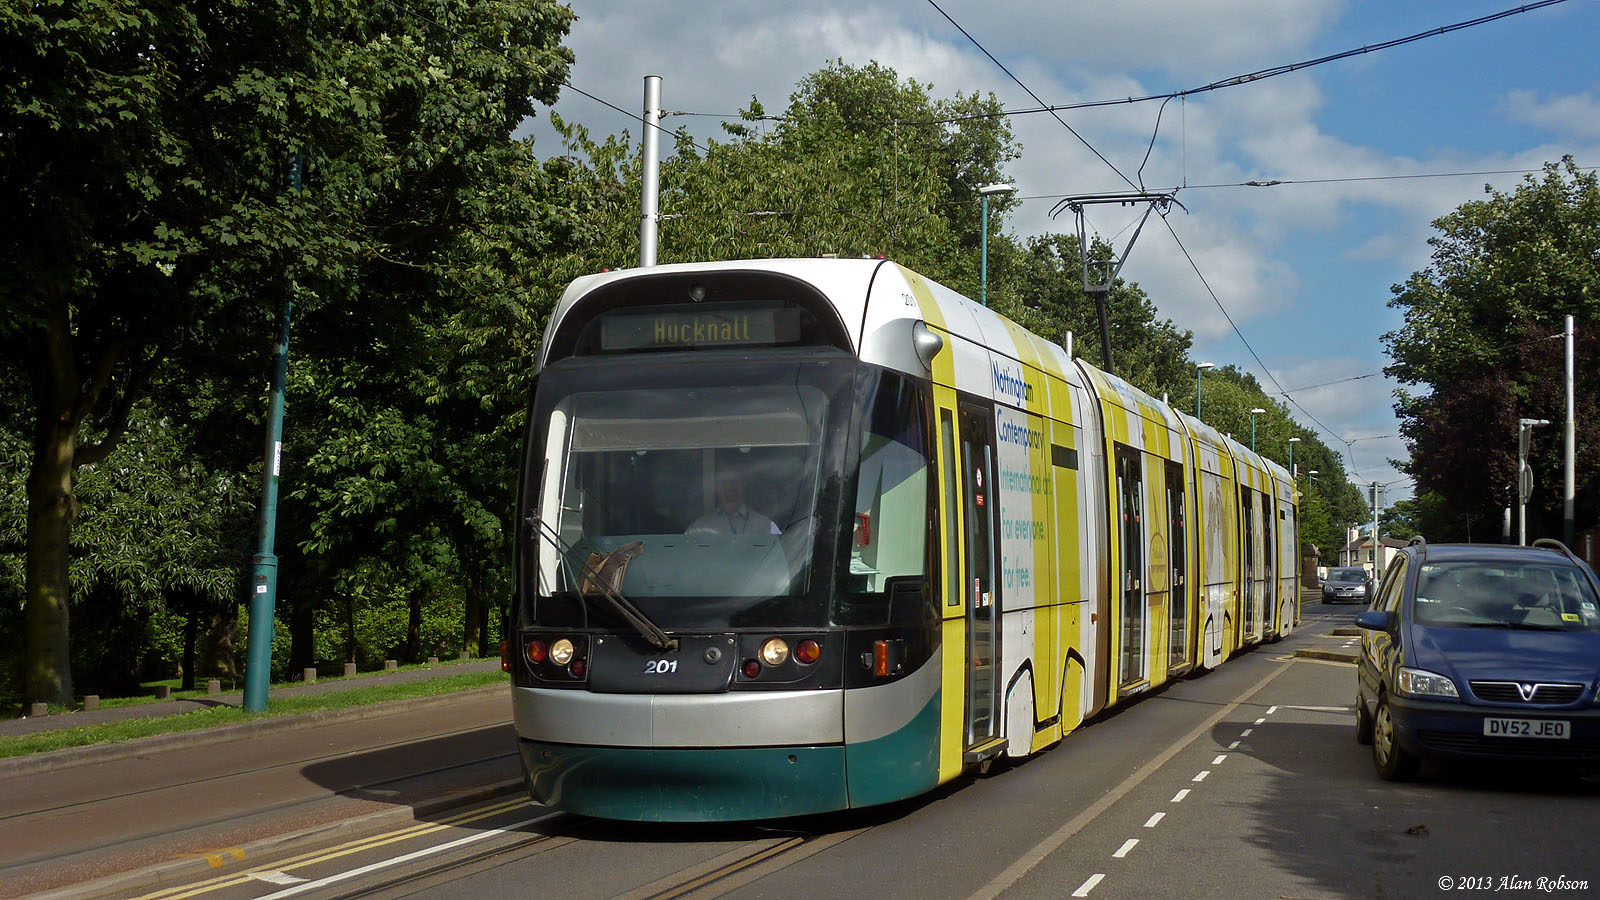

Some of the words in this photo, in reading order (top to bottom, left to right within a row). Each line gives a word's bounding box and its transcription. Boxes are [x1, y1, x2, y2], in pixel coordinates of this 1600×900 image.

[901, 293, 916, 308] 201
[654, 316, 750, 344] Hucknall
[992, 359, 1034, 407] Nottingham
[997, 408, 1045, 459] Contemporary
[999, 457, 1042, 494] International
[1002, 507, 1013, 540] For
[1015, 519, 1046, 550] everyone.
[1003, 556, 1014, 589] For
[1015, 556, 1031, 597] free.
[644, 659, 678, 674] 201
[1490, 719, 1530, 735] DV52
[1534, 721, 1564, 737] JEO
